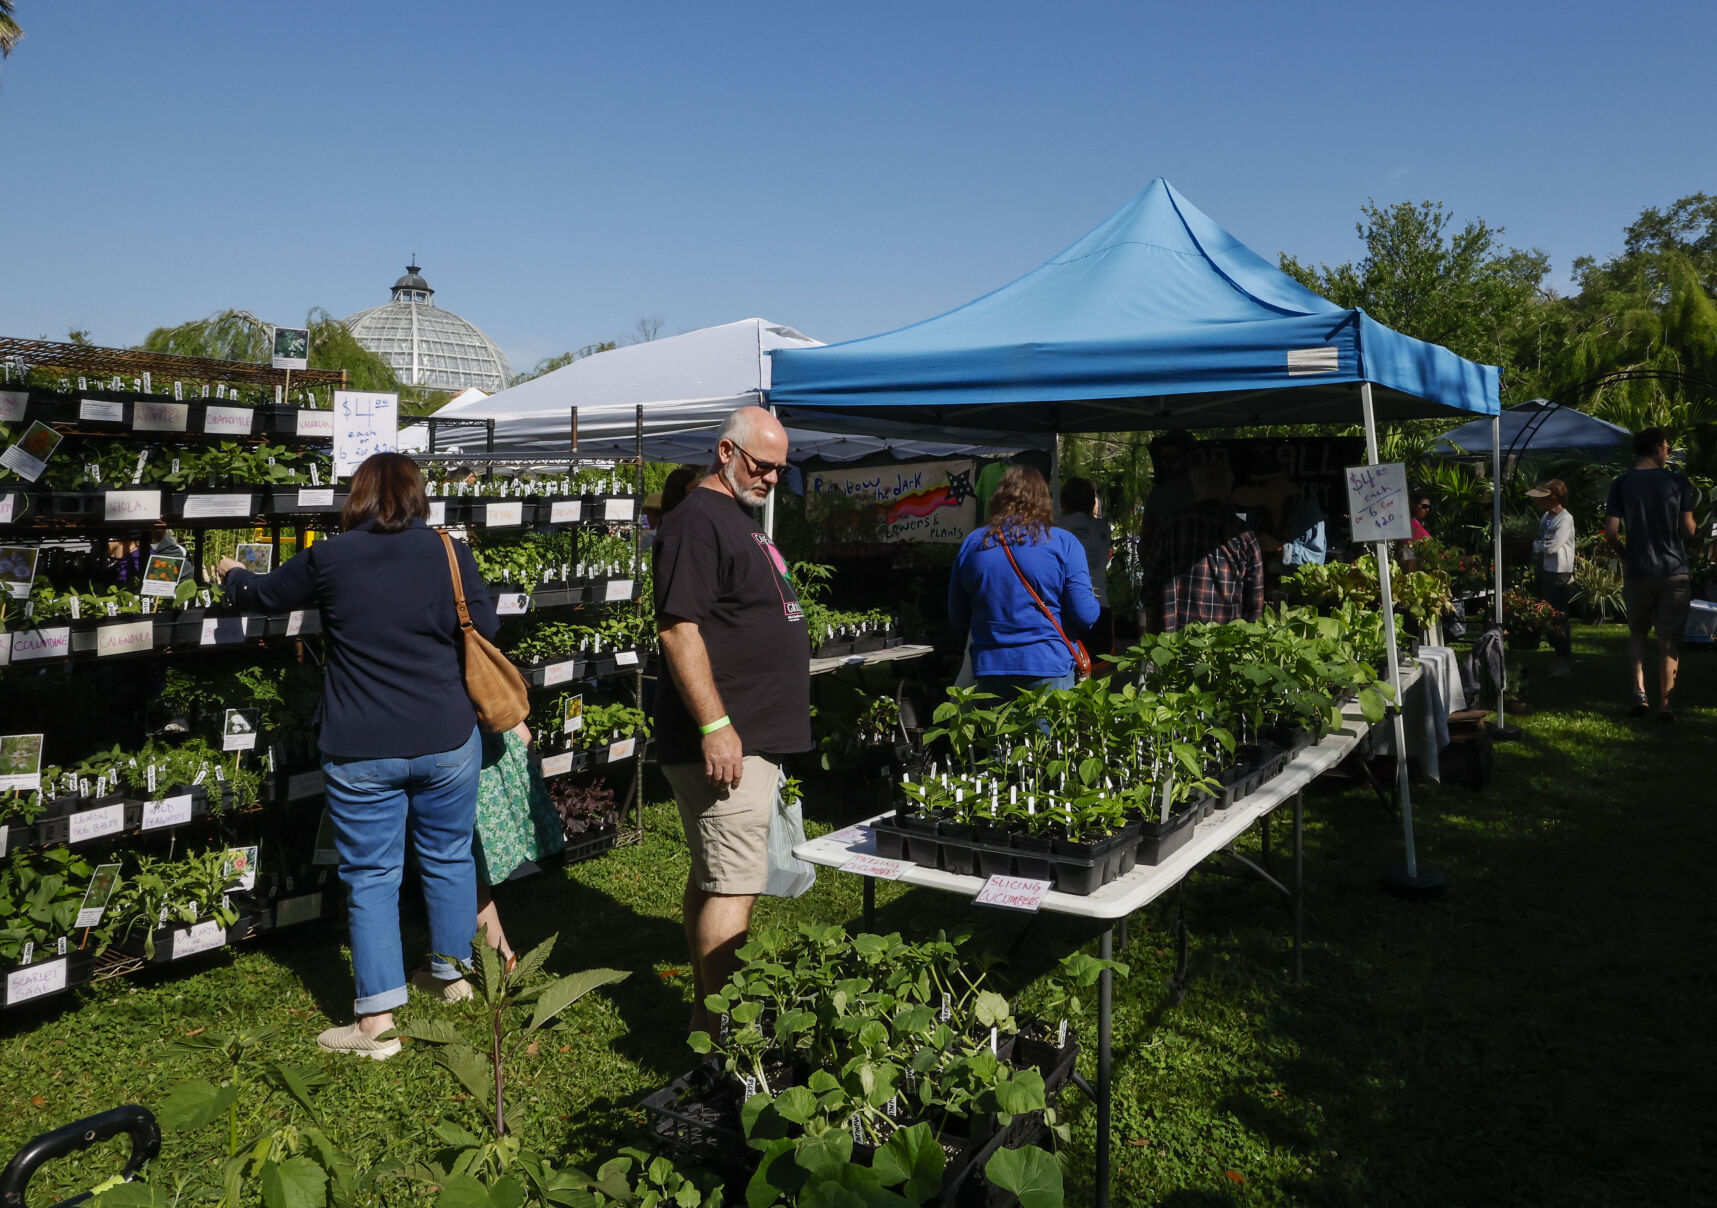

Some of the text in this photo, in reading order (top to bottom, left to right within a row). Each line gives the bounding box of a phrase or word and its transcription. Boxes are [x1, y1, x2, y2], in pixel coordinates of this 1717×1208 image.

[347, 429, 376, 438] each
[355, 447, 368, 457] for
[1364, 486, 1392, 502] each
[1369, 507, 1378, 517] 6
[100, 631, 151, 648] CALENDULA
[74, 811, 108, 825] LEMON
[72, 825, 89, 835] BEE
[991, 876, 1043, 894] SLICING
[979, 889, 1040, 907] CUCUMBERS
[12, 967, 57, 988] SCARLET
[16, 984, 49, 1000] SAGE
